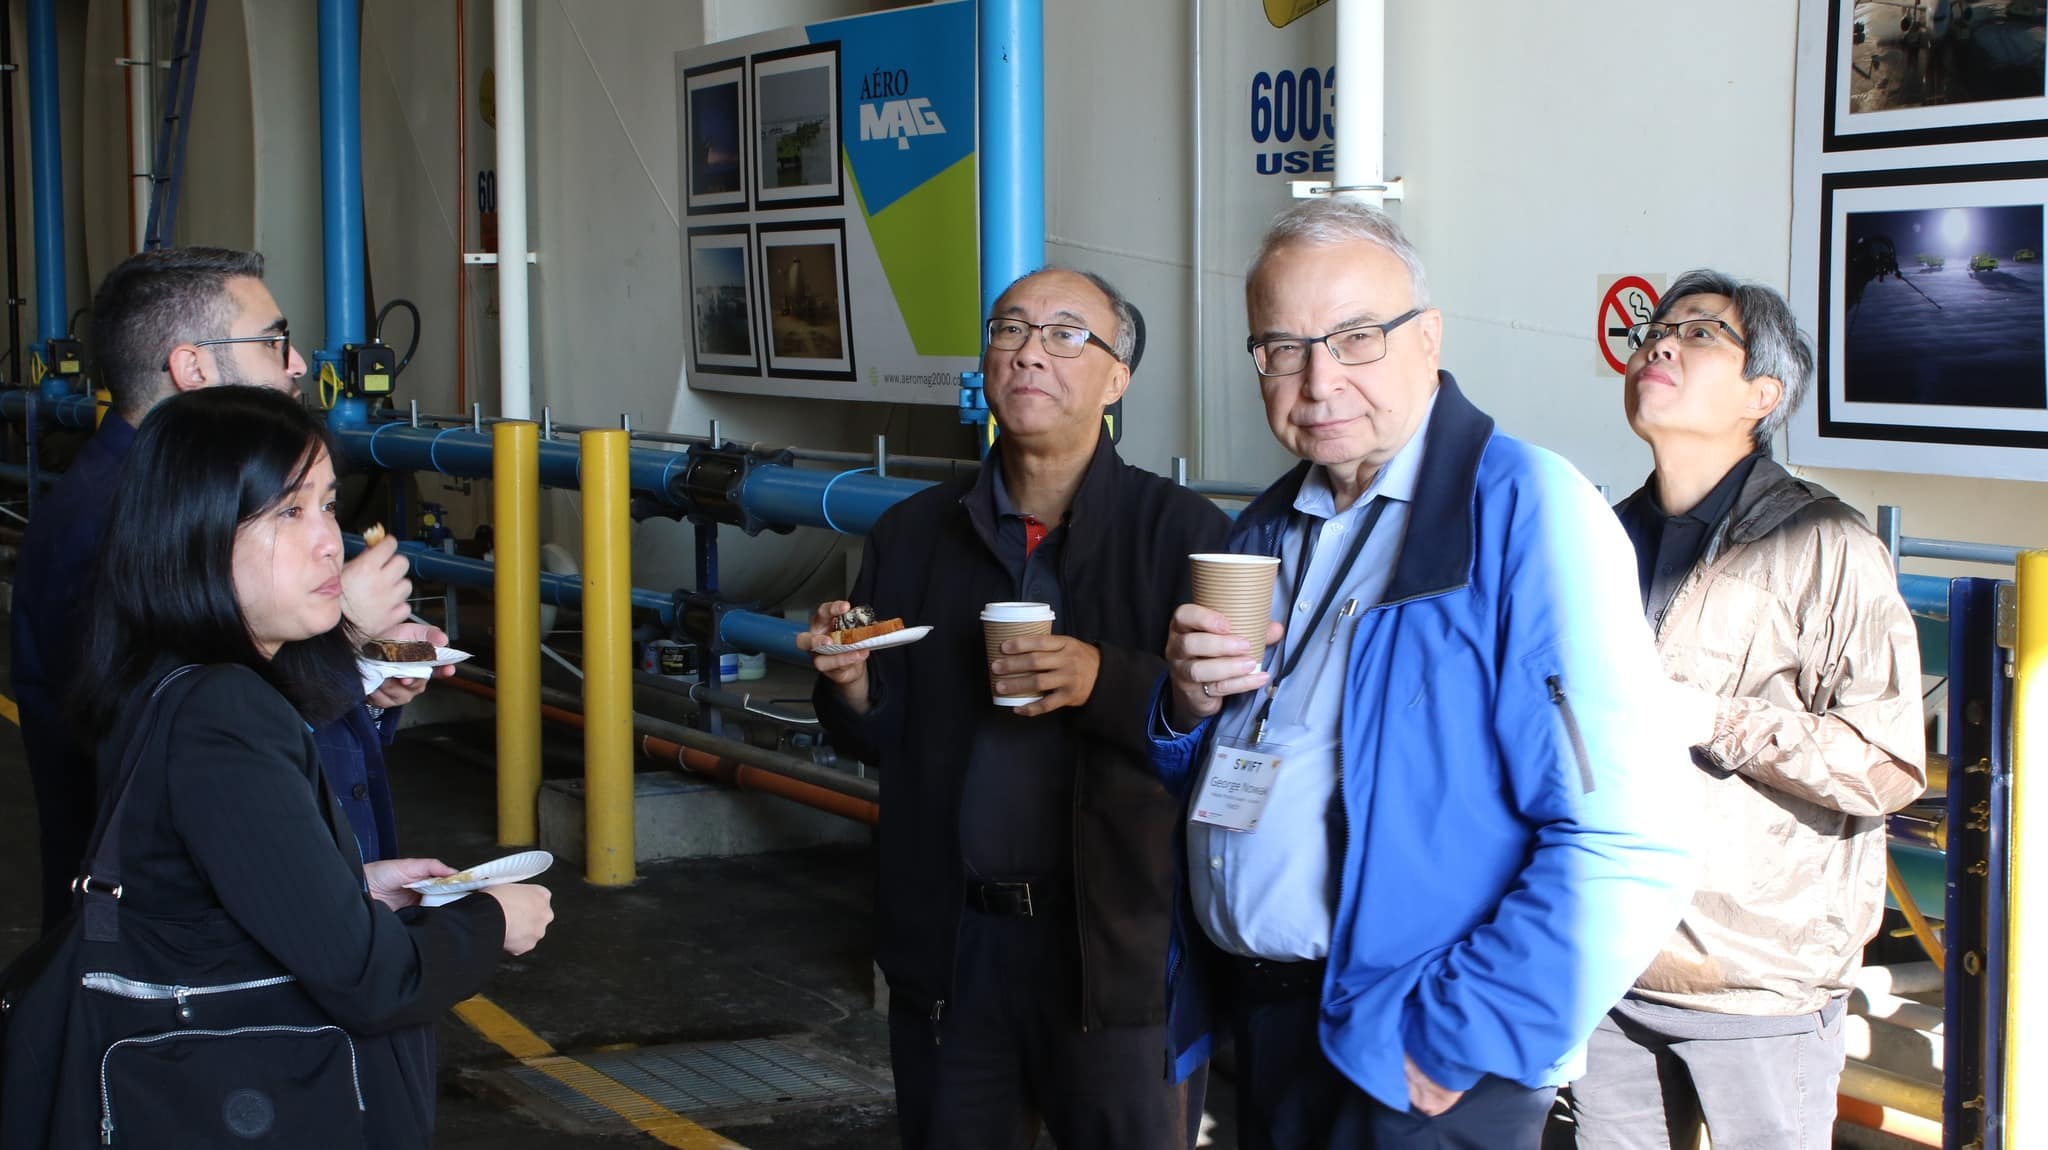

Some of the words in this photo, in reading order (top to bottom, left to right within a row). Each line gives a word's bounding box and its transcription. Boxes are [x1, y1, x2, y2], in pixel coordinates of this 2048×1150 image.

[860, 67, 909, 99] AÉRO
[859, 98, 947, 150] MAG
[1233, 758, 1263, 773] SWIFT
[1211, 776, 1241, 793] George
